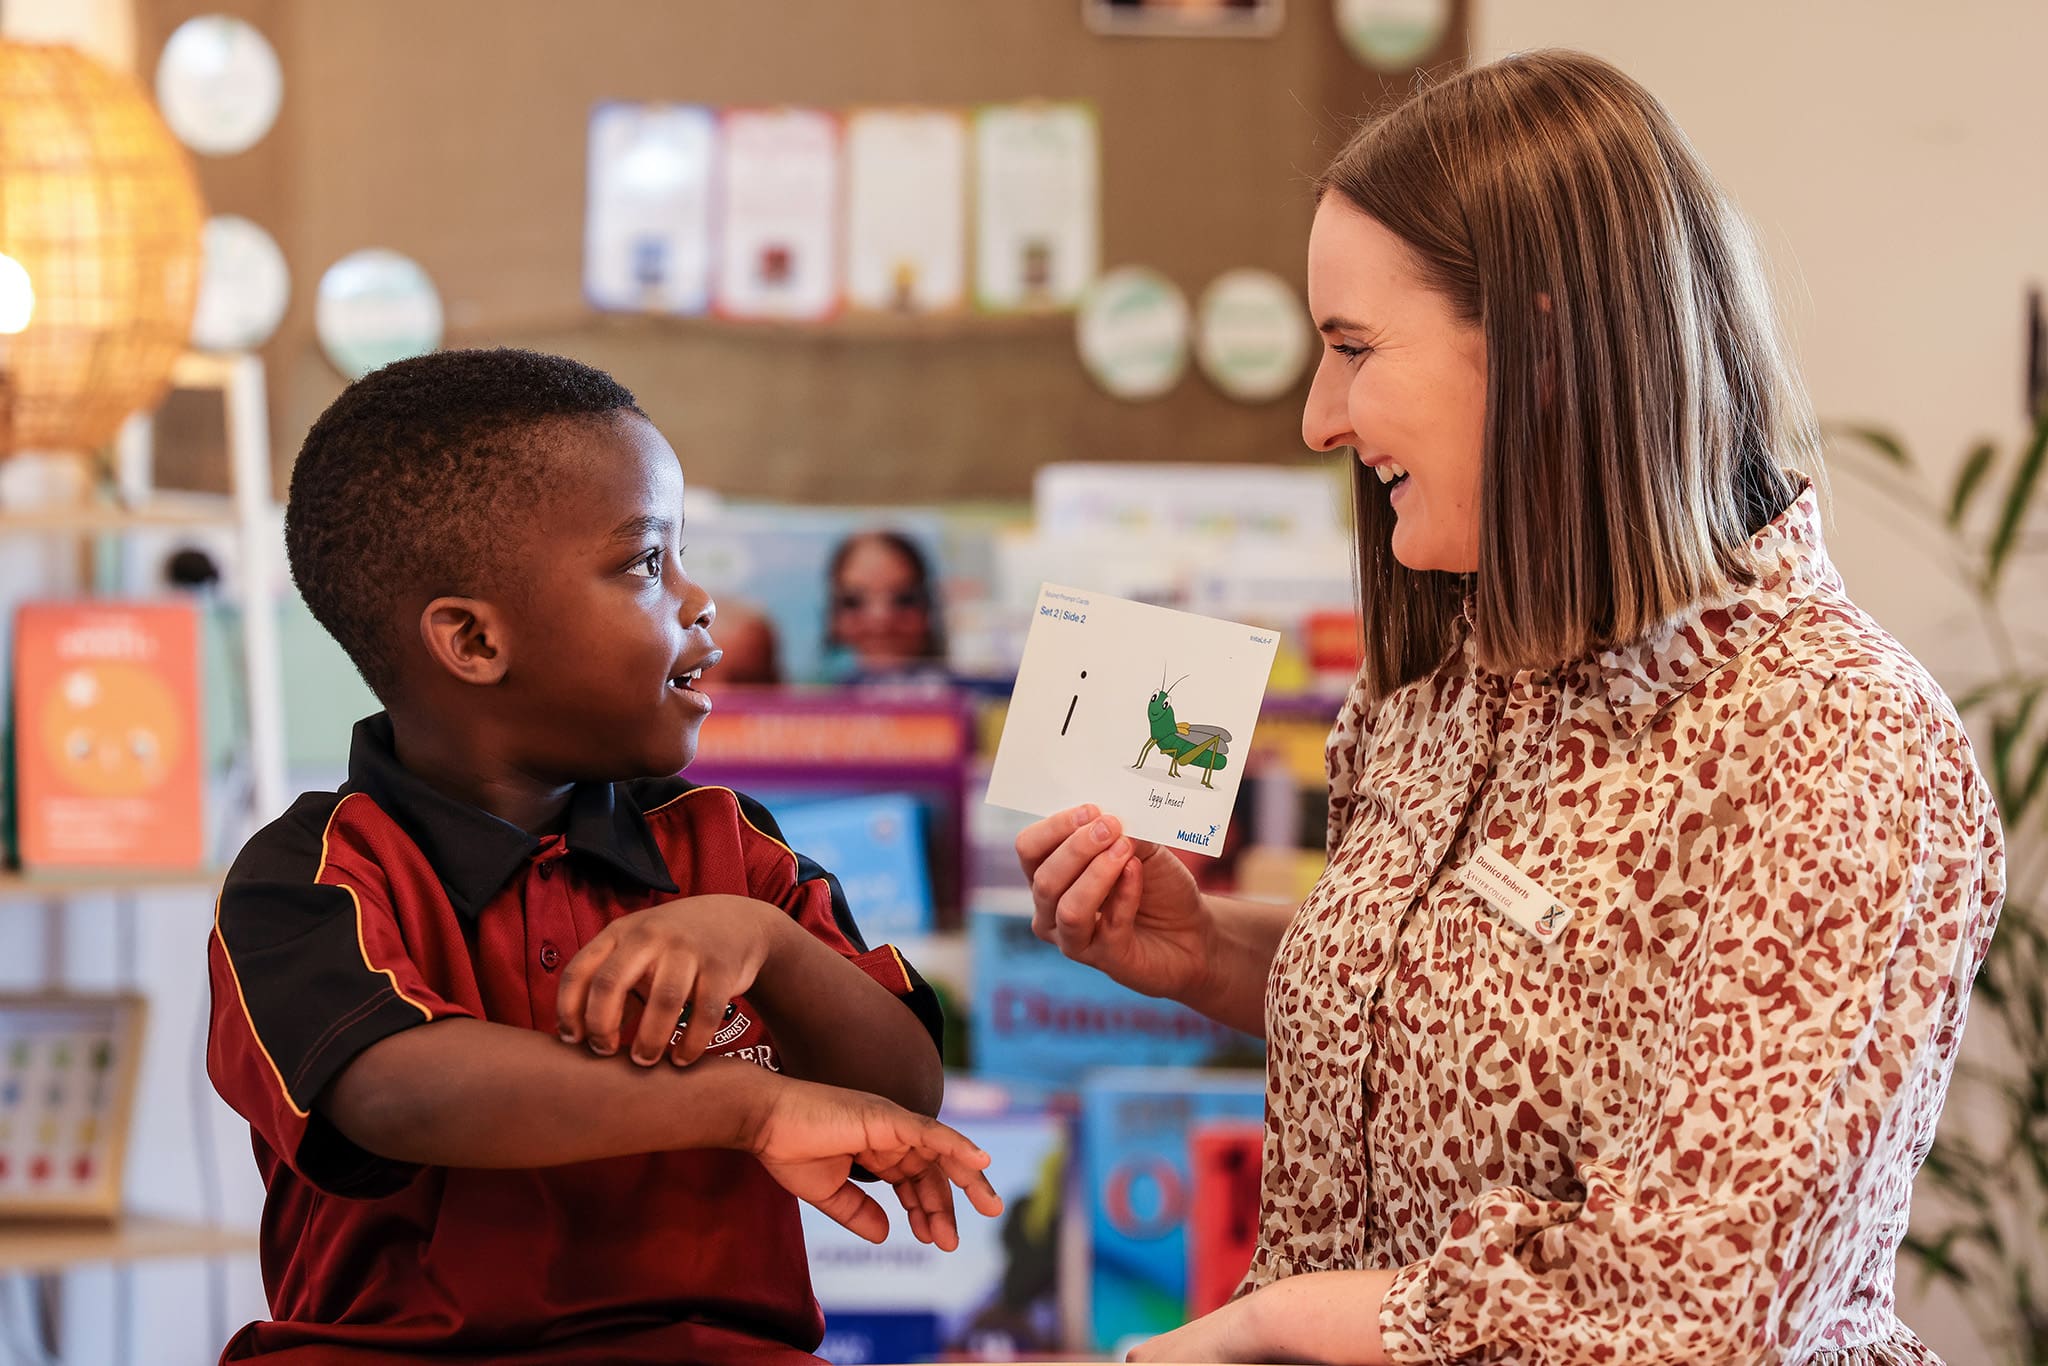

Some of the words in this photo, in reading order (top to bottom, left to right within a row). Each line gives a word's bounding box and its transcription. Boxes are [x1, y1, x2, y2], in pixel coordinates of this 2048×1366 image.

[1040, 605, 1053, 616] Set
[1053, 609, 1060, 618] 2
[1063, 610, 1079, 622] Side
[1080, 615, 1086, 624] 2
[1061, 670, 1087, 736] i
[1149, 789, 1163, 808] Iggy
[1165, 792, 1185, 808] Insect
[1177, 830, 1209, 846] MultiLit
[1476, 855, 1501, 879] Danica
[1501, 875, 1529, 899] Roberts
[715, 1018, 746, 1044] CHRIST
